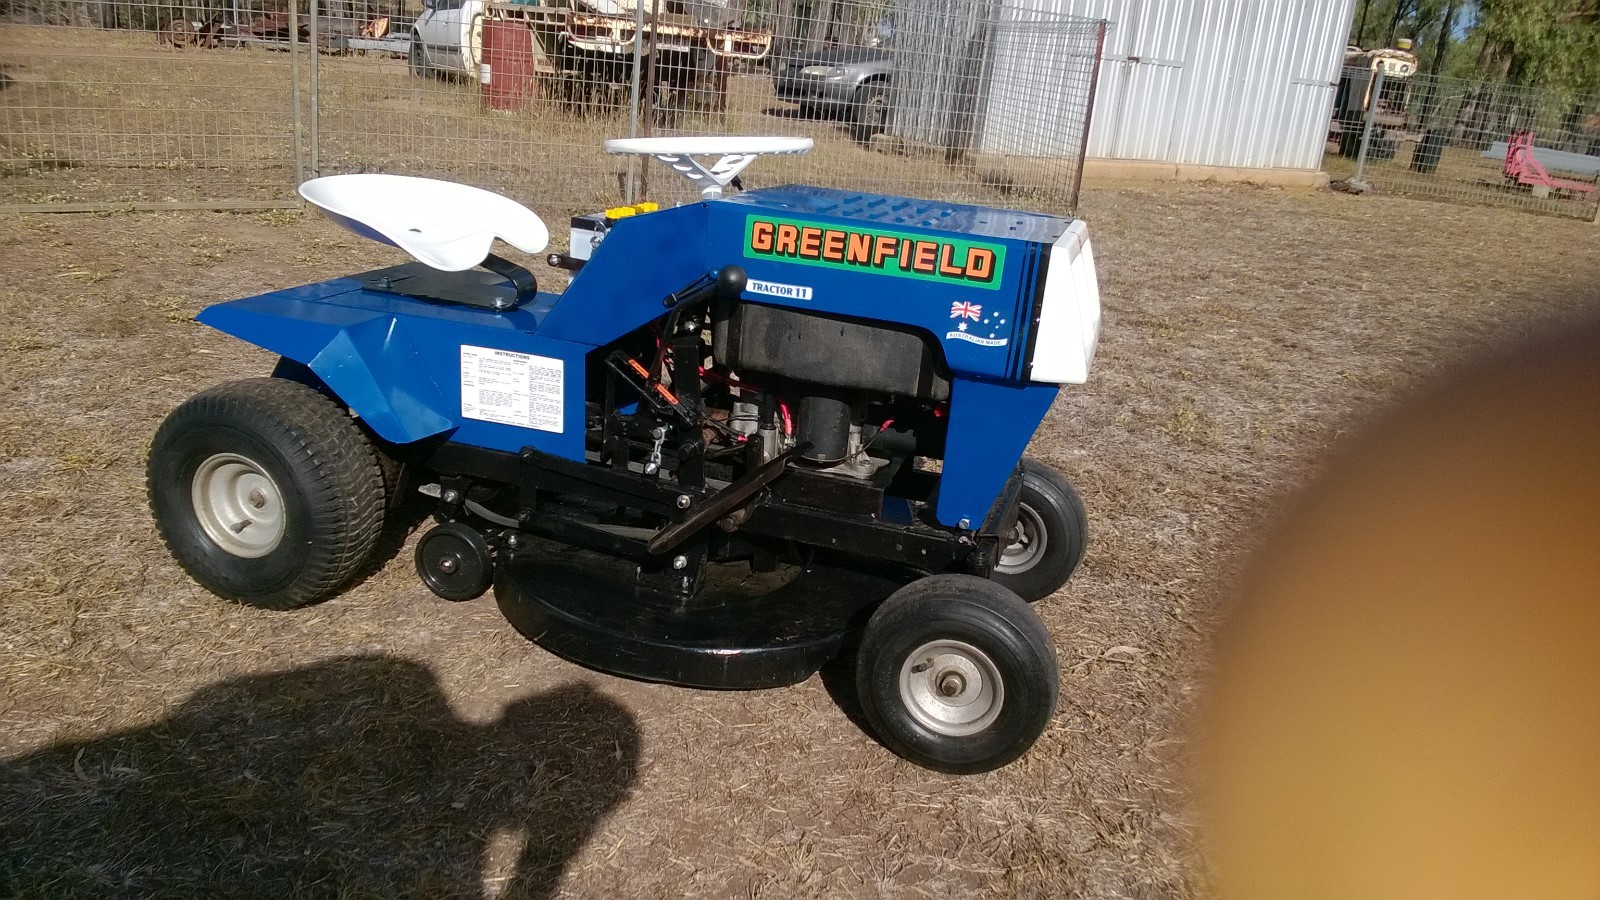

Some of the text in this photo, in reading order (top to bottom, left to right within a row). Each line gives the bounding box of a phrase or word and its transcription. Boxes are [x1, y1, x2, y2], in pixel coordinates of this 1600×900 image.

[752, 221, 996, 284] GREENFIELD
[752, 282, 807, 298] TRACTOR 11
[949, 332, 985, 345] AUSTRALIAN
[494, 351, 530, 360] INSTRUCTIONS
